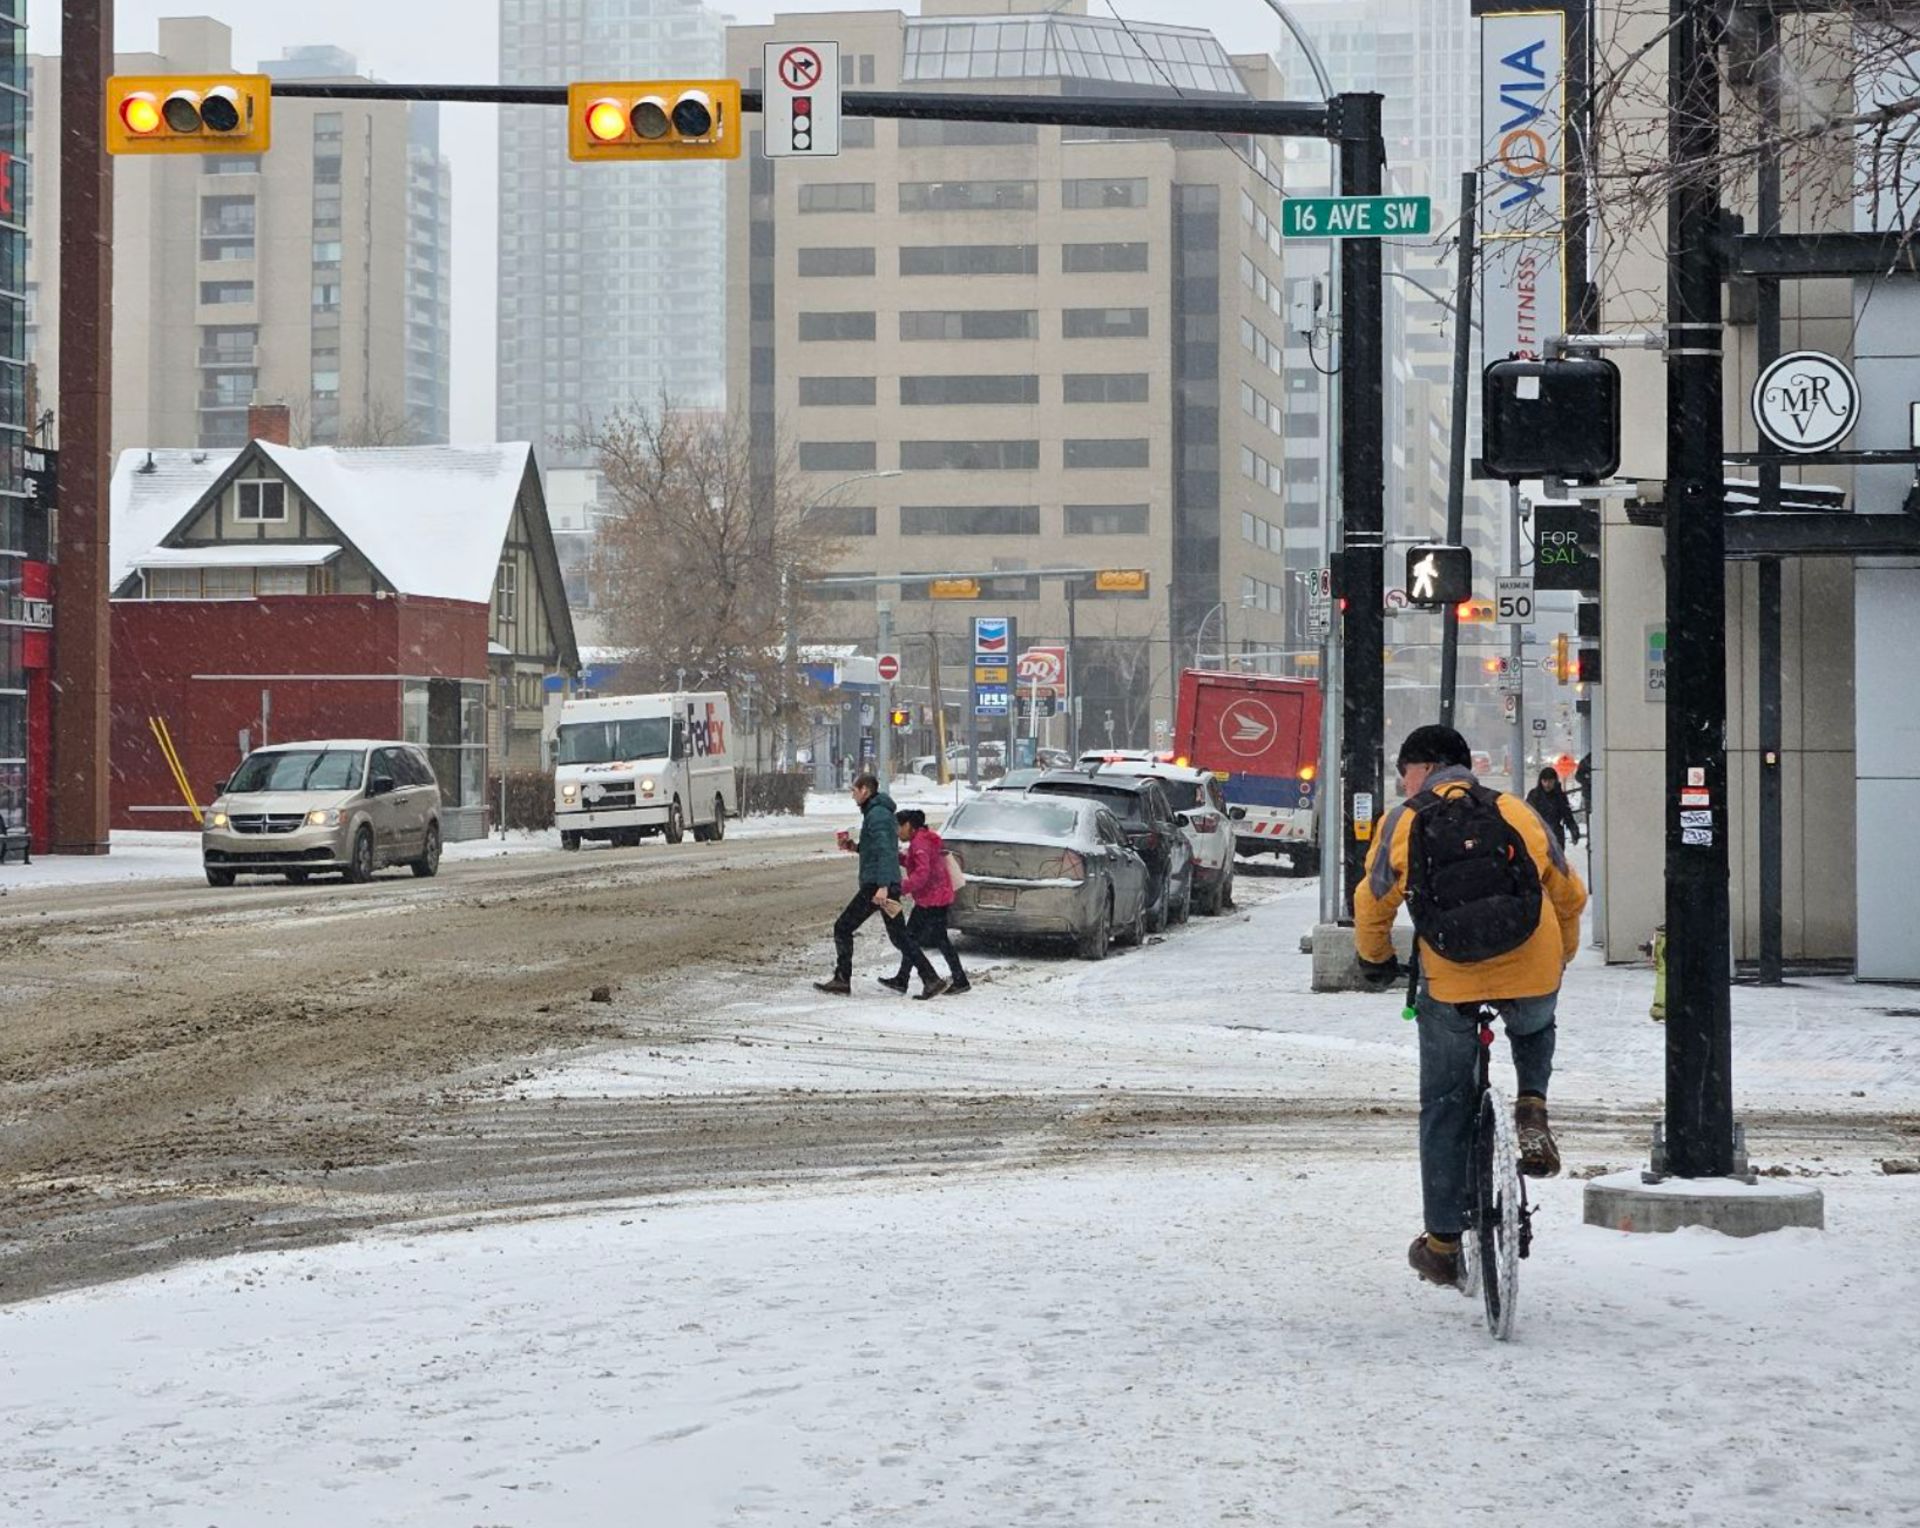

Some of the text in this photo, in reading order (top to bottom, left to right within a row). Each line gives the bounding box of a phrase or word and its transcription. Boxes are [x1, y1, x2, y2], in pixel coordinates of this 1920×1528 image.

[1500, 39, 1546, 210] VOVIA
[1294, 203, 1418, 231] 16 AVE SW
[1517, 257, 1536, 344] FITNESS
[1541, 531, 1579, 545] FOR
[1500, 597, 1532, 617] 50
[1020, 661, 1050, 678] DQ
[687, 703, 727, 757] FedEx
[585, 761, 634, 773] FedEx
